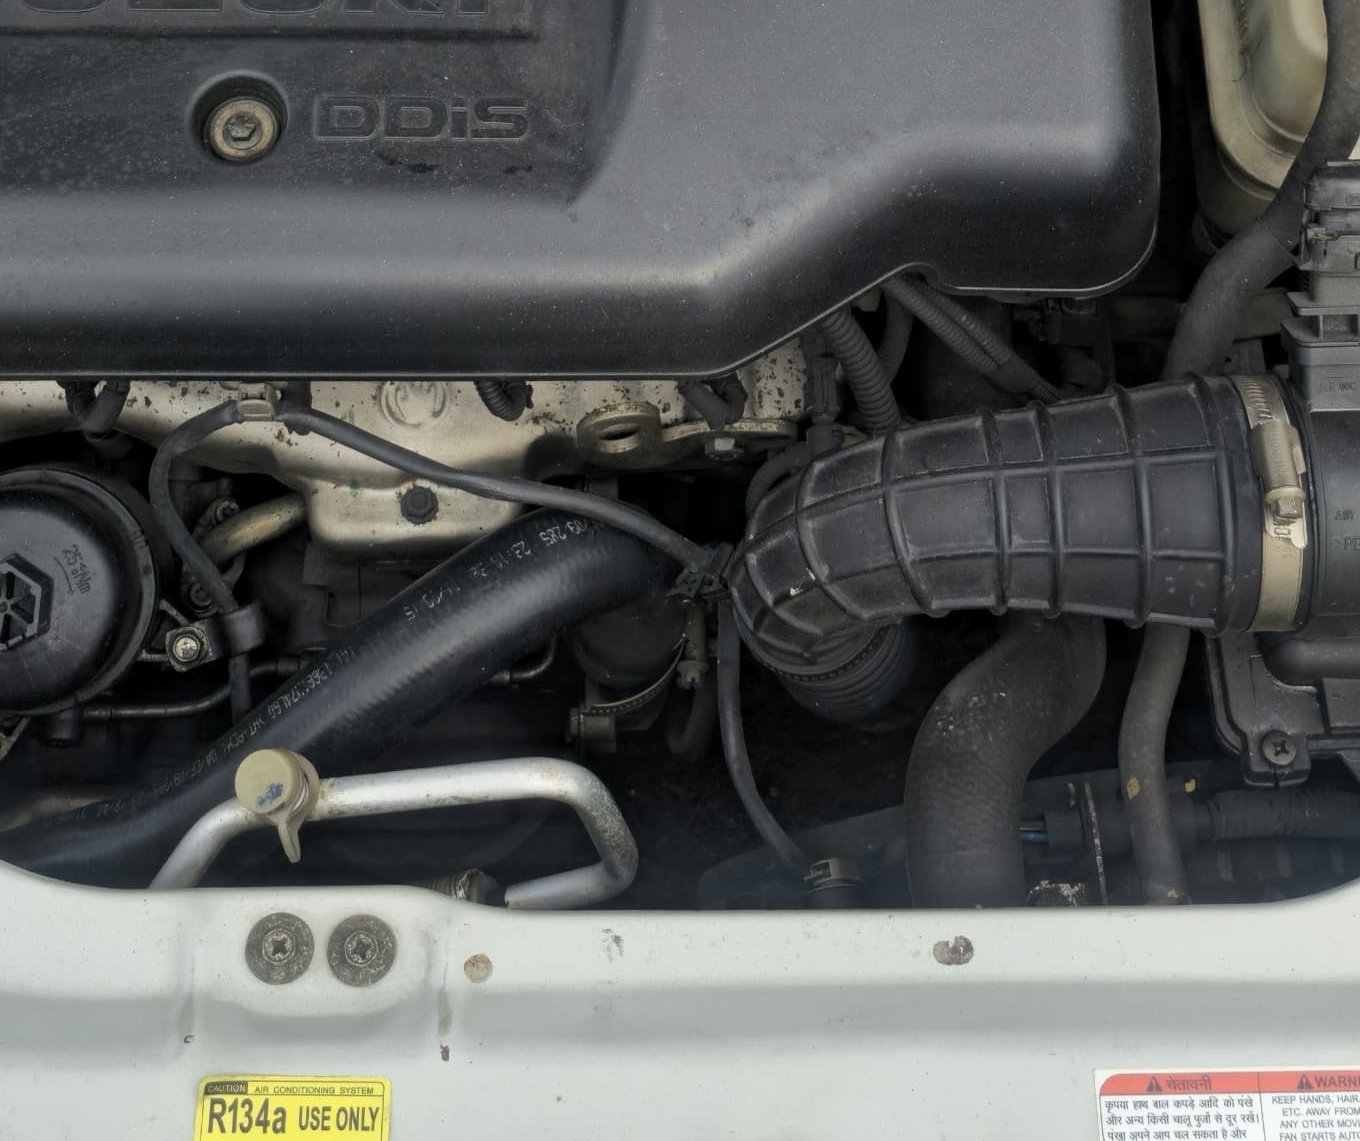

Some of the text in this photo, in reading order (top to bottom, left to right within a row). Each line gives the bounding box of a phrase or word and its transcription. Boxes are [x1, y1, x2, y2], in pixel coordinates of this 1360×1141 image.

[313, 96, 530, 143] DDiS
[207, 1082, 246, 1093] CAUTION
[273, 1086, 336, 1094] CONDITIONING
[339, 1087, 374, 1095] SYSTEM
[1166, 1074, 1212, 1092] चेतावनी
[1104, 1099, 1129, 1113] कृपया
[1133, 1100, 1148, 1110] हाथ
[1152, 1099, 1169, 1109] बाल
[1199, 1096, 1218, 1108] आदि
[1223, 1095, 1235, 1108] को
[1272, 1095, 1296, 1104] KEEP
[1299, 1095, 1334, 1105] HANDS,
[1337, 1094, 1360, 1104] HAIR,
[207, 1097, 380, 1134] R134a USE ONLY
[1282, 1108, 1303, 1117] ETC.
[1306, 1107, 1331, 1116] AWAY
[1334, 1106, 1360, 1115] FROM
[1106, 1113, 1122, 1126] और
[1280, 1119, 1297, 1129] ANY
[1301, 1119, 1334, 1128] OTHER
[1279, 1132, 1297, 1141] FAN
[1300, 1131, 1336, 1141] STARTS
